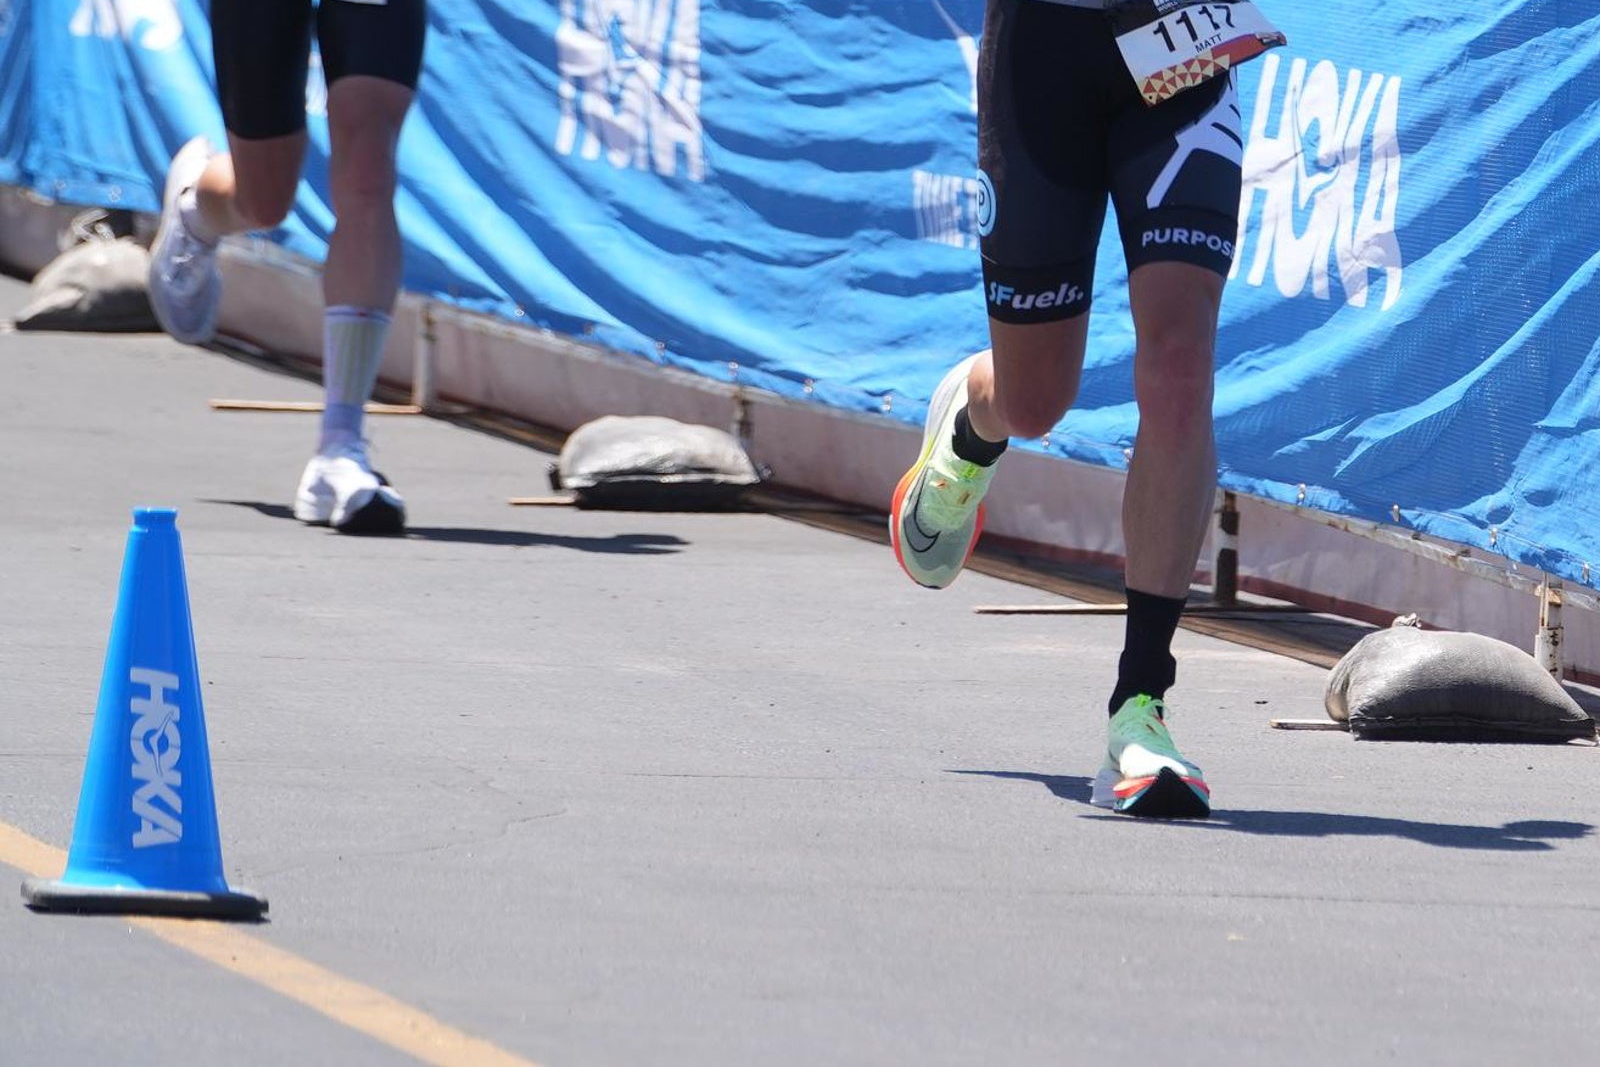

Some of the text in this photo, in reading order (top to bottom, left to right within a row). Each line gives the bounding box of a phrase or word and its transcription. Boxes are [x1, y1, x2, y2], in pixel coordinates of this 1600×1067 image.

[1153, 5, 1235, 53] 1117
[1195, 33, 1223, 53] MATT
[1228, 54, 1402, 312] HOKA
[988, 281, 1084, 310] SFuels.
[130, 667, 183, 848] HOKA
